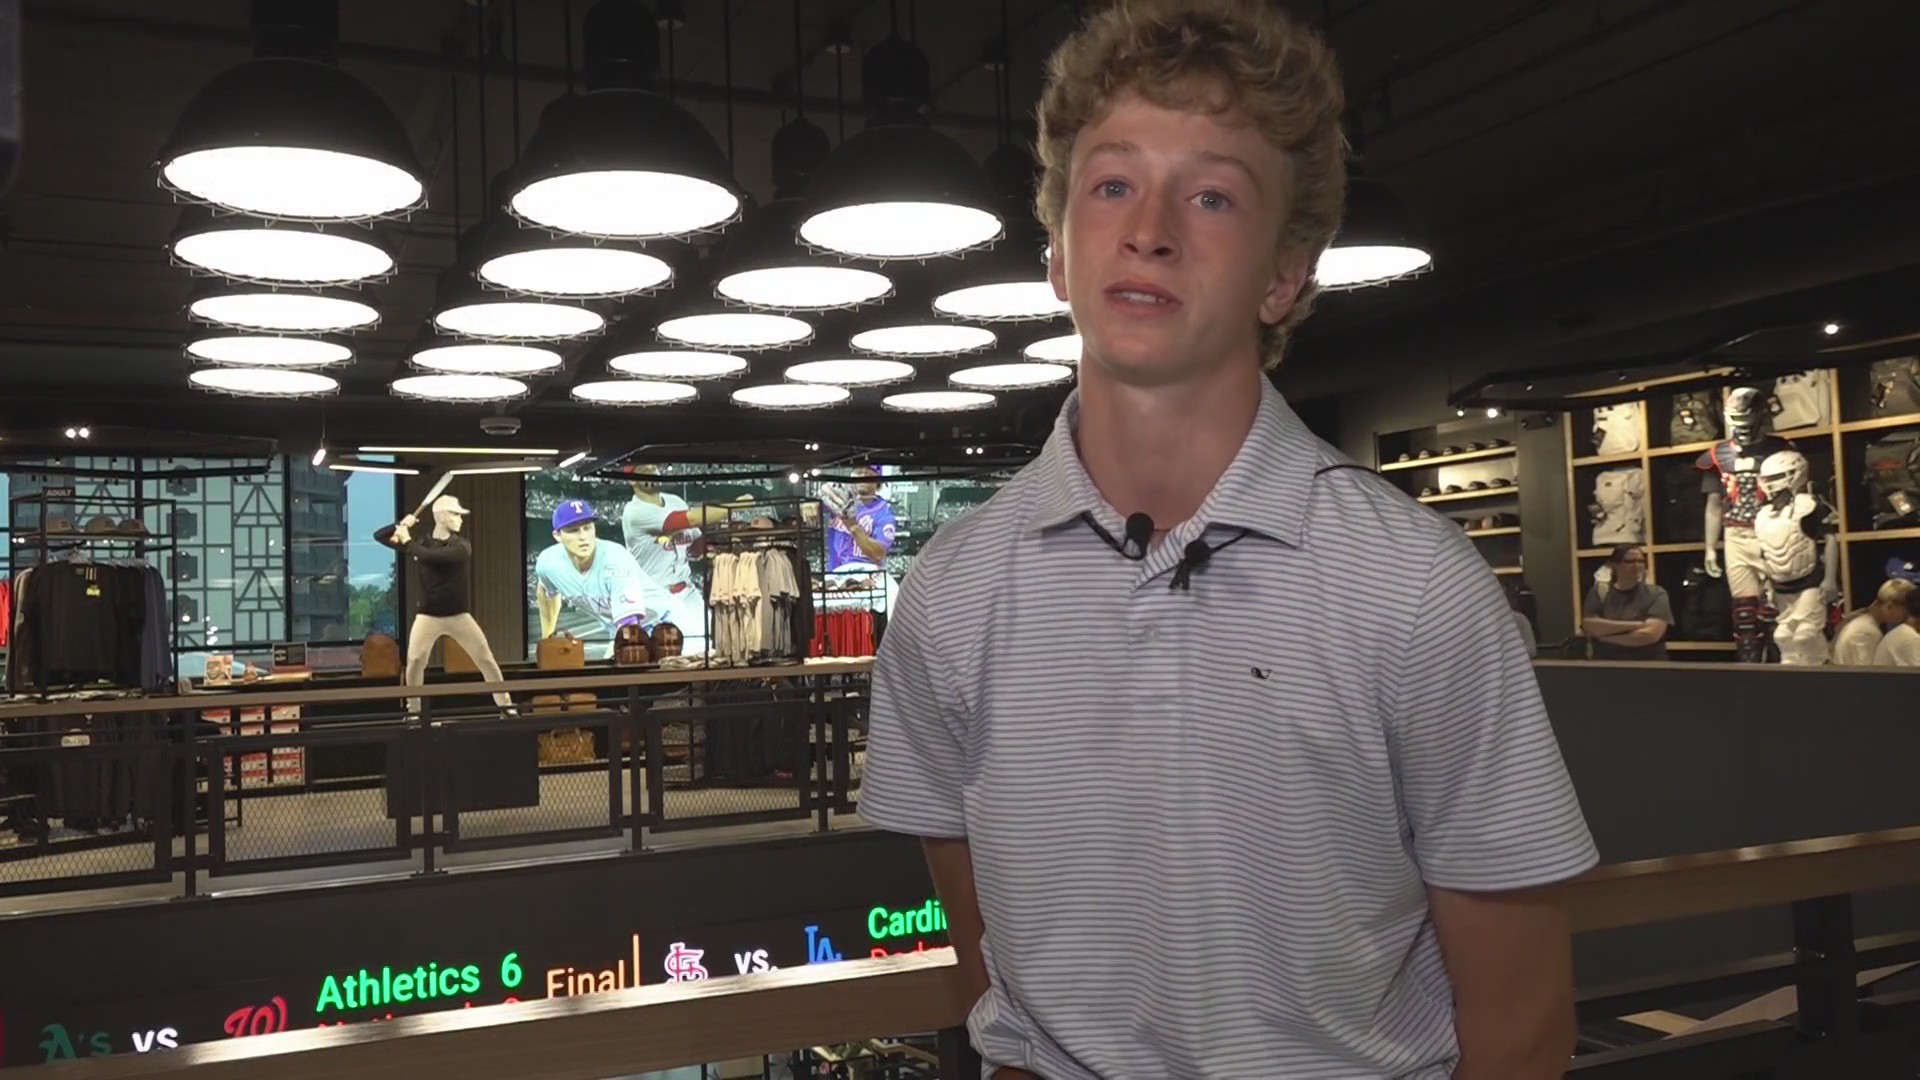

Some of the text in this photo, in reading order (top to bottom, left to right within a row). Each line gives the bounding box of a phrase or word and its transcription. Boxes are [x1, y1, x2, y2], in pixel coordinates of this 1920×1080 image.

[316, 952, 522, 1012] Athletics 6
[547, 959, 625, 1000] Final
